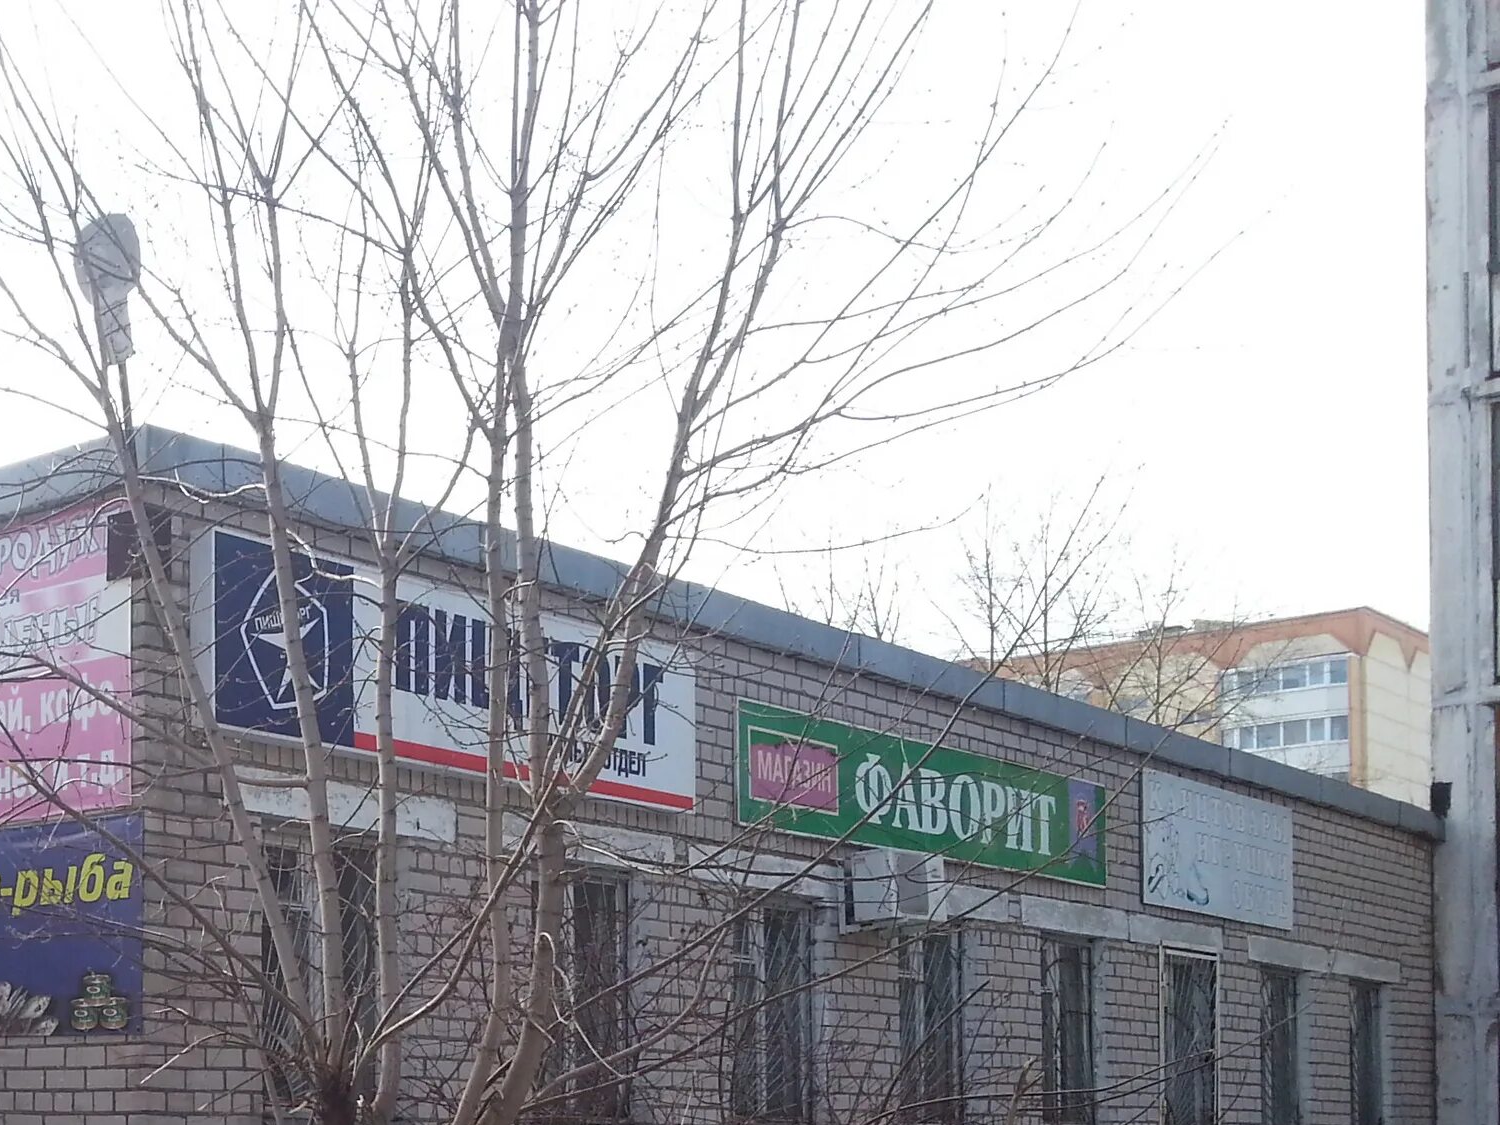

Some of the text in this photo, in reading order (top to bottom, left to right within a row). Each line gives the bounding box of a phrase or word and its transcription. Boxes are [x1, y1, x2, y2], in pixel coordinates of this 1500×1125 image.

[396, 600, 663, 745] ПИЩТОРГ
[756, 750, 832, 793] МАГАЗИН
[855, 754, 1056, 856] ФАВОРИТ
[1148, 778, 1290, 845] КАНЦТОВАРЫ
[1195, 831, 1289, 881] ИГРУШКИ
[1232, 880, 1289, 919] ОБУВЬ
